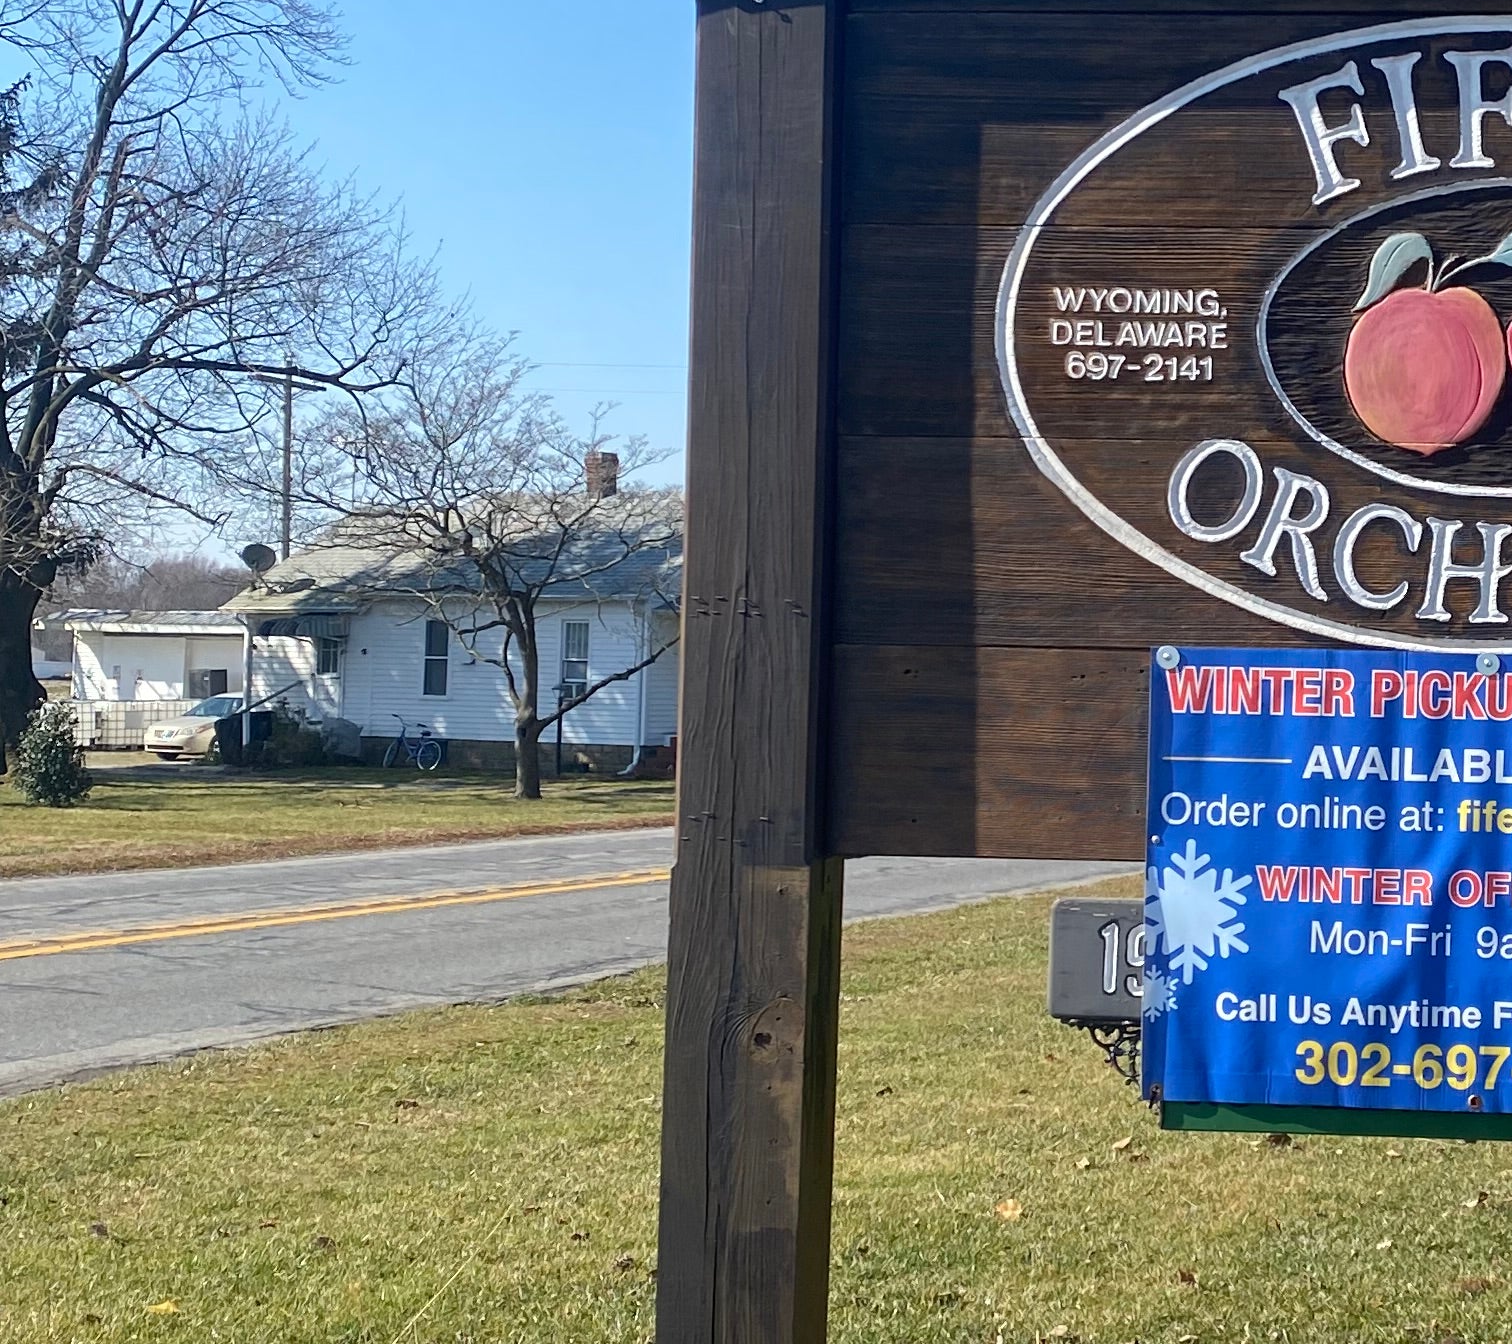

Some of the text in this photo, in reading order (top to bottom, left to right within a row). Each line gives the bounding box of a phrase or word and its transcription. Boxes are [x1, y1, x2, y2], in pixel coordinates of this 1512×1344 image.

[1052, 286, 1228, 319] WYOMING,
[1050, 319, 1228, 349] DELAWARE
[1065, 350, 1214, 382] 697-2141
[1165, 667, 1355, 718] WINTER
[1161, 792, 1265, 828] Order
[1276, 795, 1386, 832] online
[1399, 800, 1446, 833] at:
[1255, 864, 1432, 906] WINTER
[1309, 920, 1453, 957] Mon-Fri
[1214, 991, 1278, 1023] Call
[1287, 996, 1331, 1026] Us
[1341, 997, 1482, 1034] Anytime
